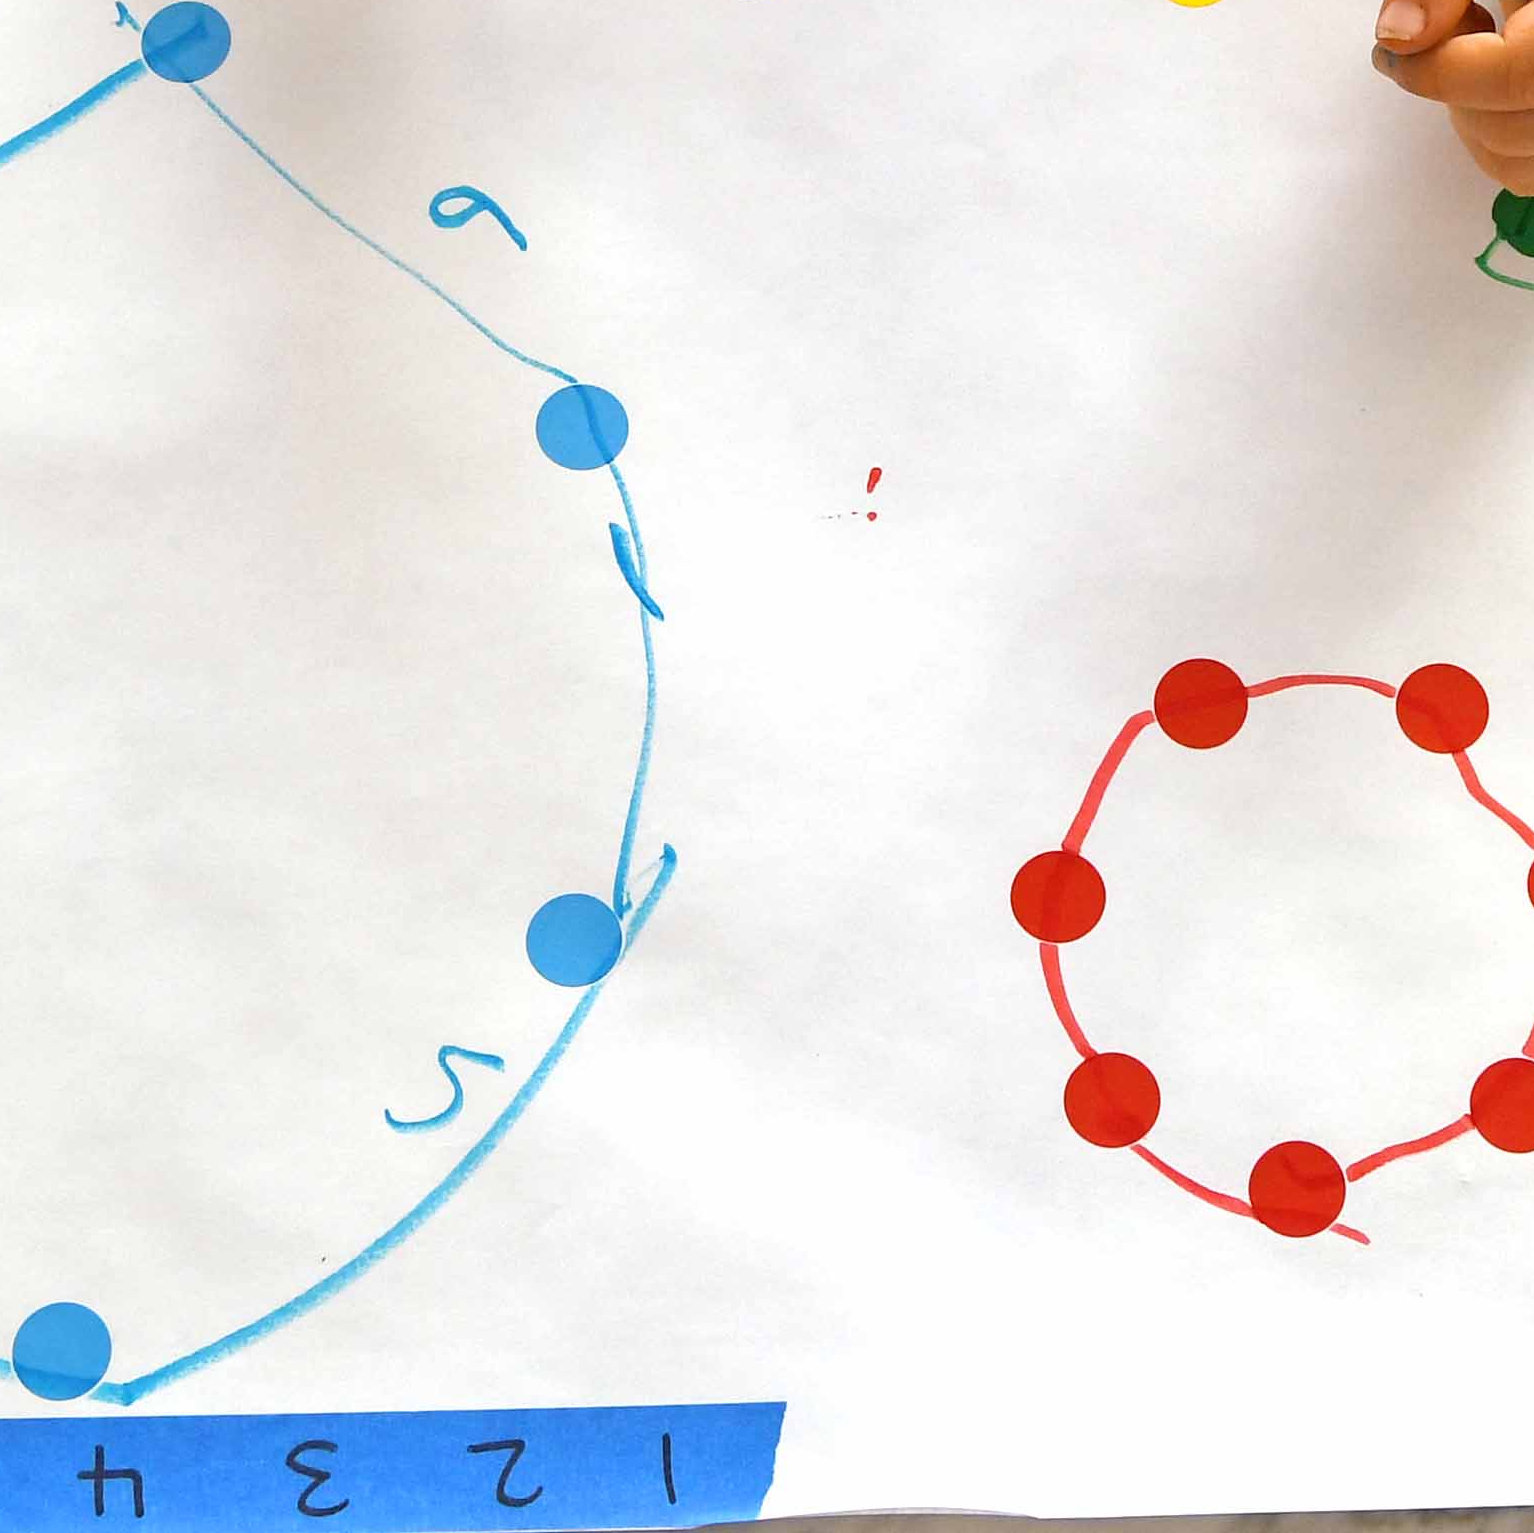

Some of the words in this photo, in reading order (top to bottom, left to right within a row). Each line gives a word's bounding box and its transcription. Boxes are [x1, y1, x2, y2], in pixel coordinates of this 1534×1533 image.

[76, 1443, 145, 1519] 4
[284, 1439, 350, 1517] 3
[466, 1438, 543, 1508] 2
